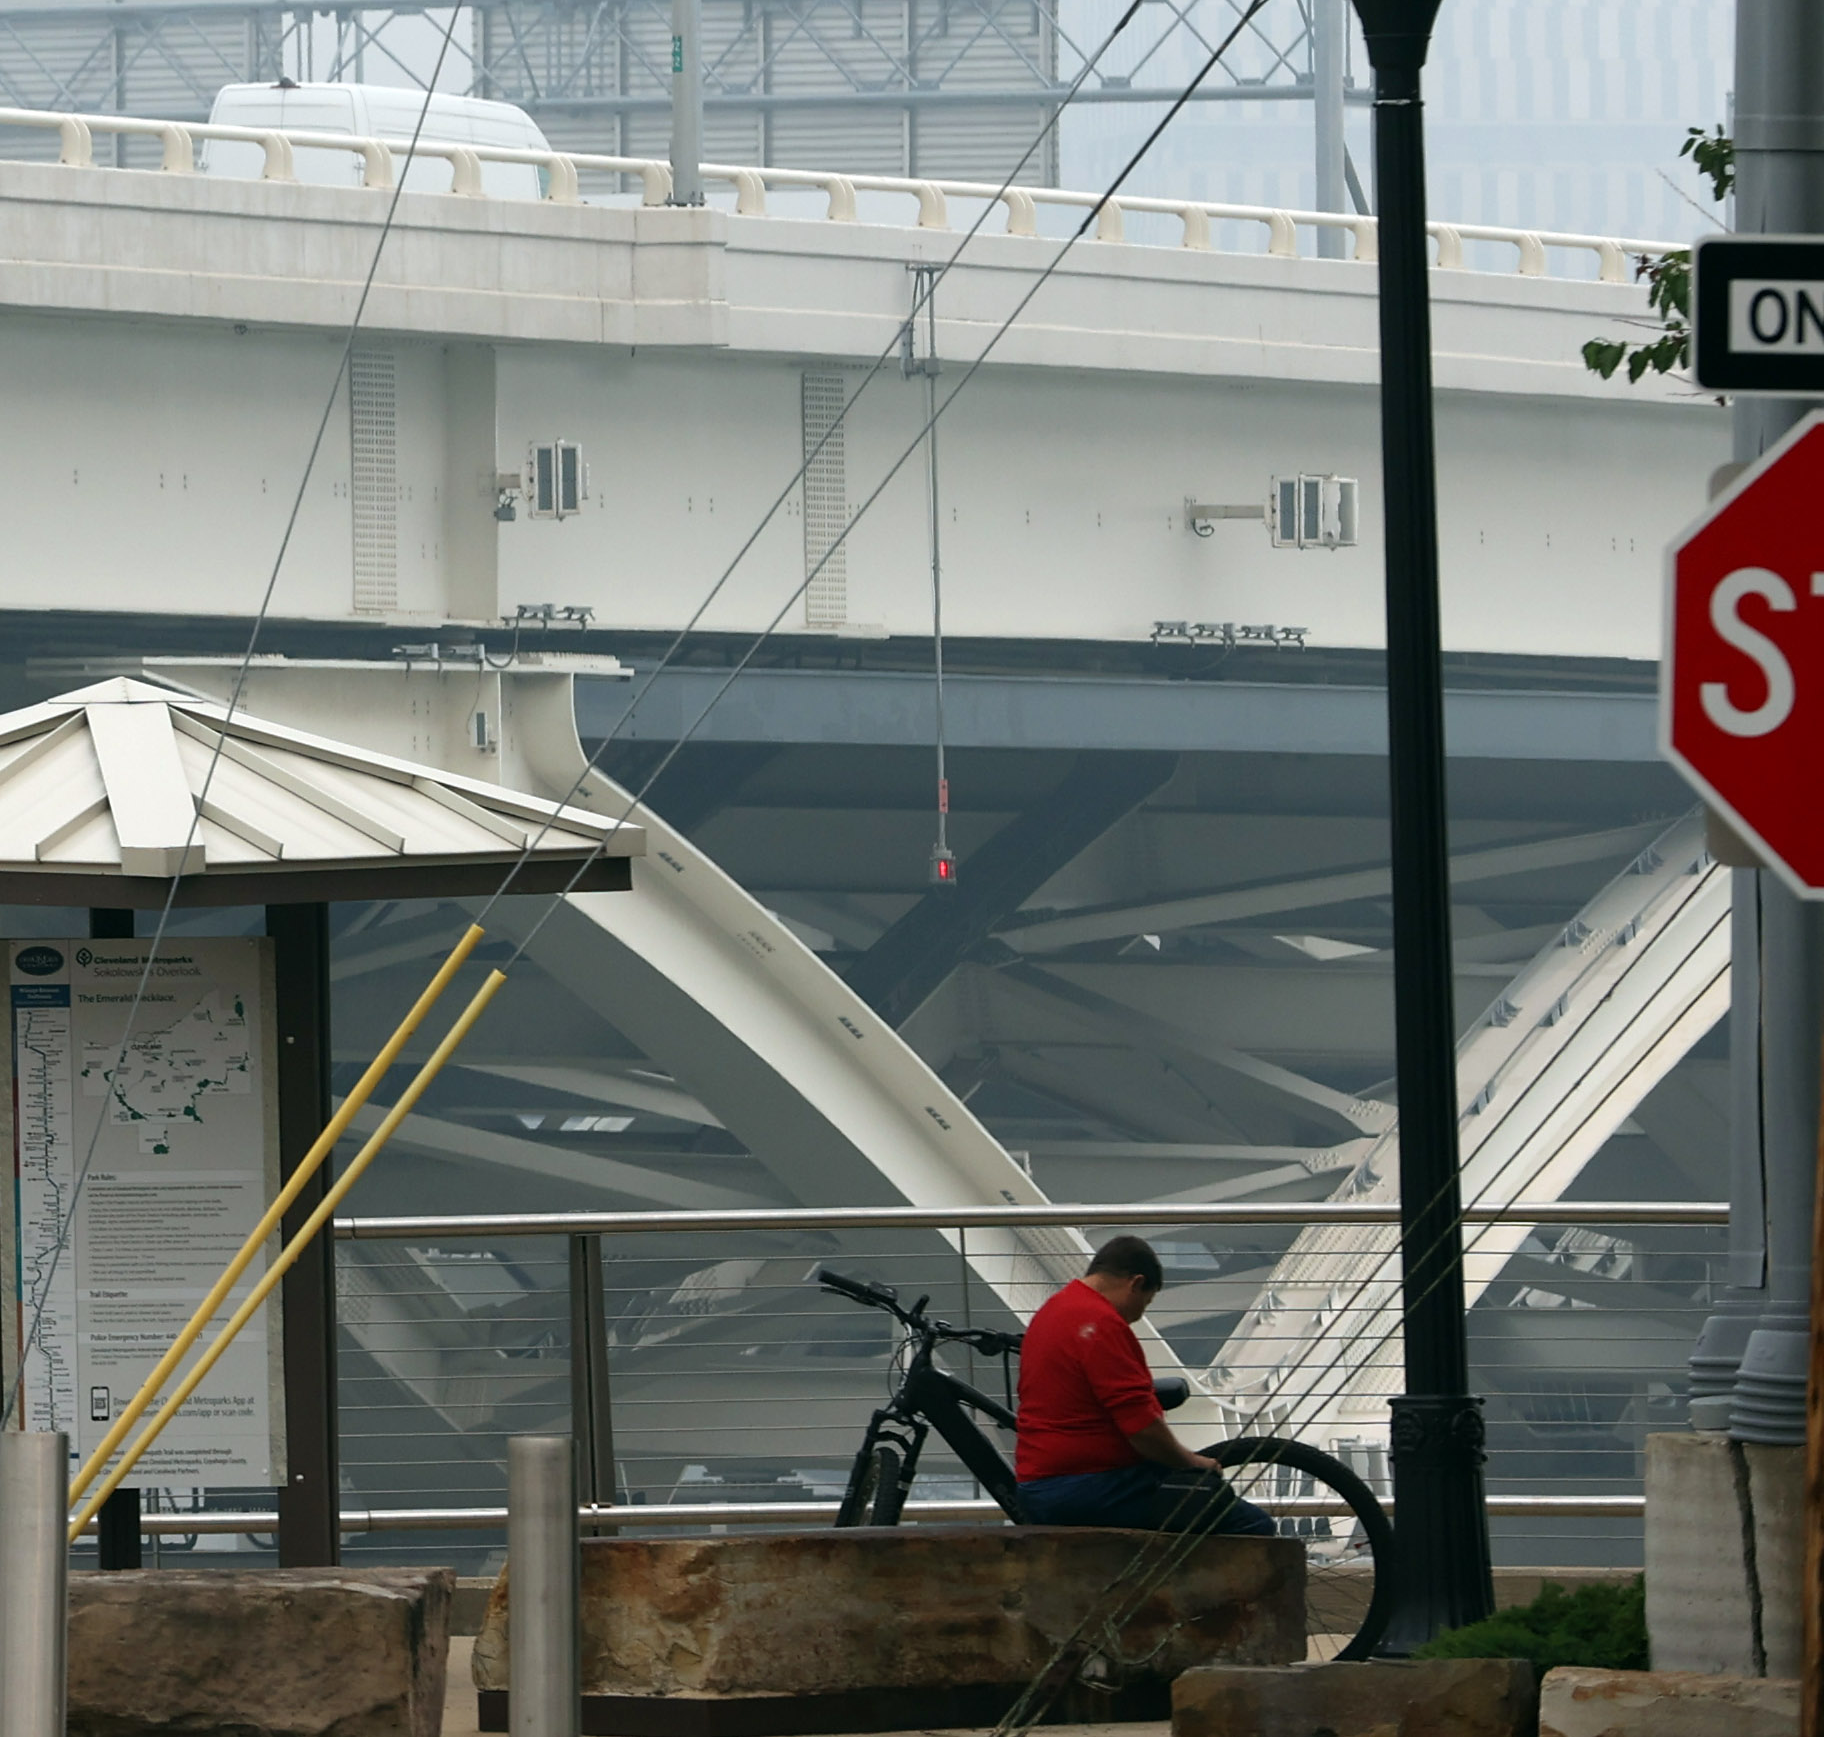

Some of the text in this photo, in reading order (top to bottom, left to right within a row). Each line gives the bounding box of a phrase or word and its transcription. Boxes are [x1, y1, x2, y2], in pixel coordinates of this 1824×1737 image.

[1699, 566, 1824, 737] S
[94, 955, 193, 965] Cleveland Mtroparks
[94, 966, 154, 977] Sokolowsks
[78, 993, 95, 1003] The
[96, 993, 134, 1003] Emerald
